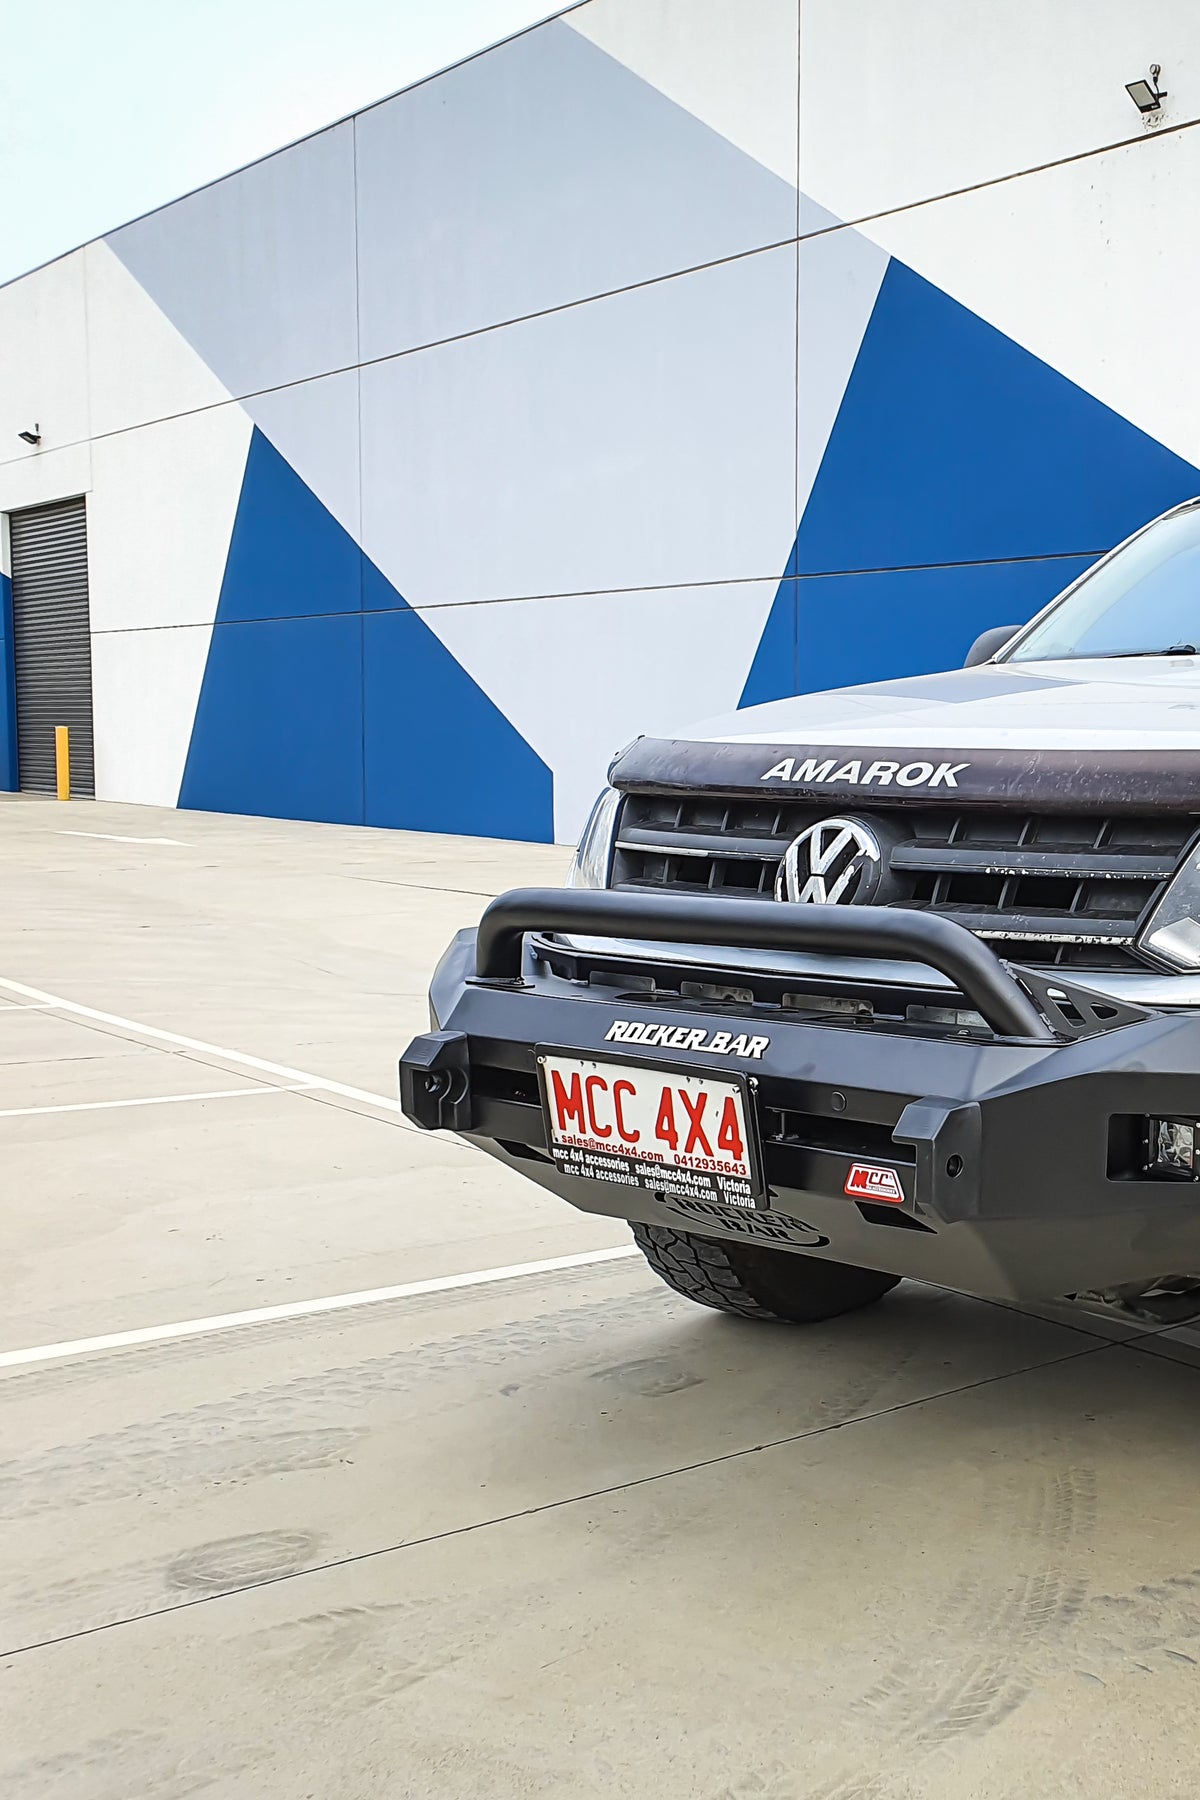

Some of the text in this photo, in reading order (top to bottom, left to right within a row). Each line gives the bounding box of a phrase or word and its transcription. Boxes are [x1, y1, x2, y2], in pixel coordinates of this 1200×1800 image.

[760, 758, 971, 787] AMAROK
[604, 1020, 770, 1059] ROCKER BAR
[551, 1069, 744, 1161] MCC 4X4
[552, 1148, 751, 1195] mcc 4x4 accessories sales@mcc4x4.com Victoria
[562, 1134, 747, 1176] sales@mcc4x4.com 0412935643
[564, 1163, 756, 1209] mcc 4x4 accessories sales@mcc4x4.com Victoria
[850, 1169, 895, 1189] MCC
